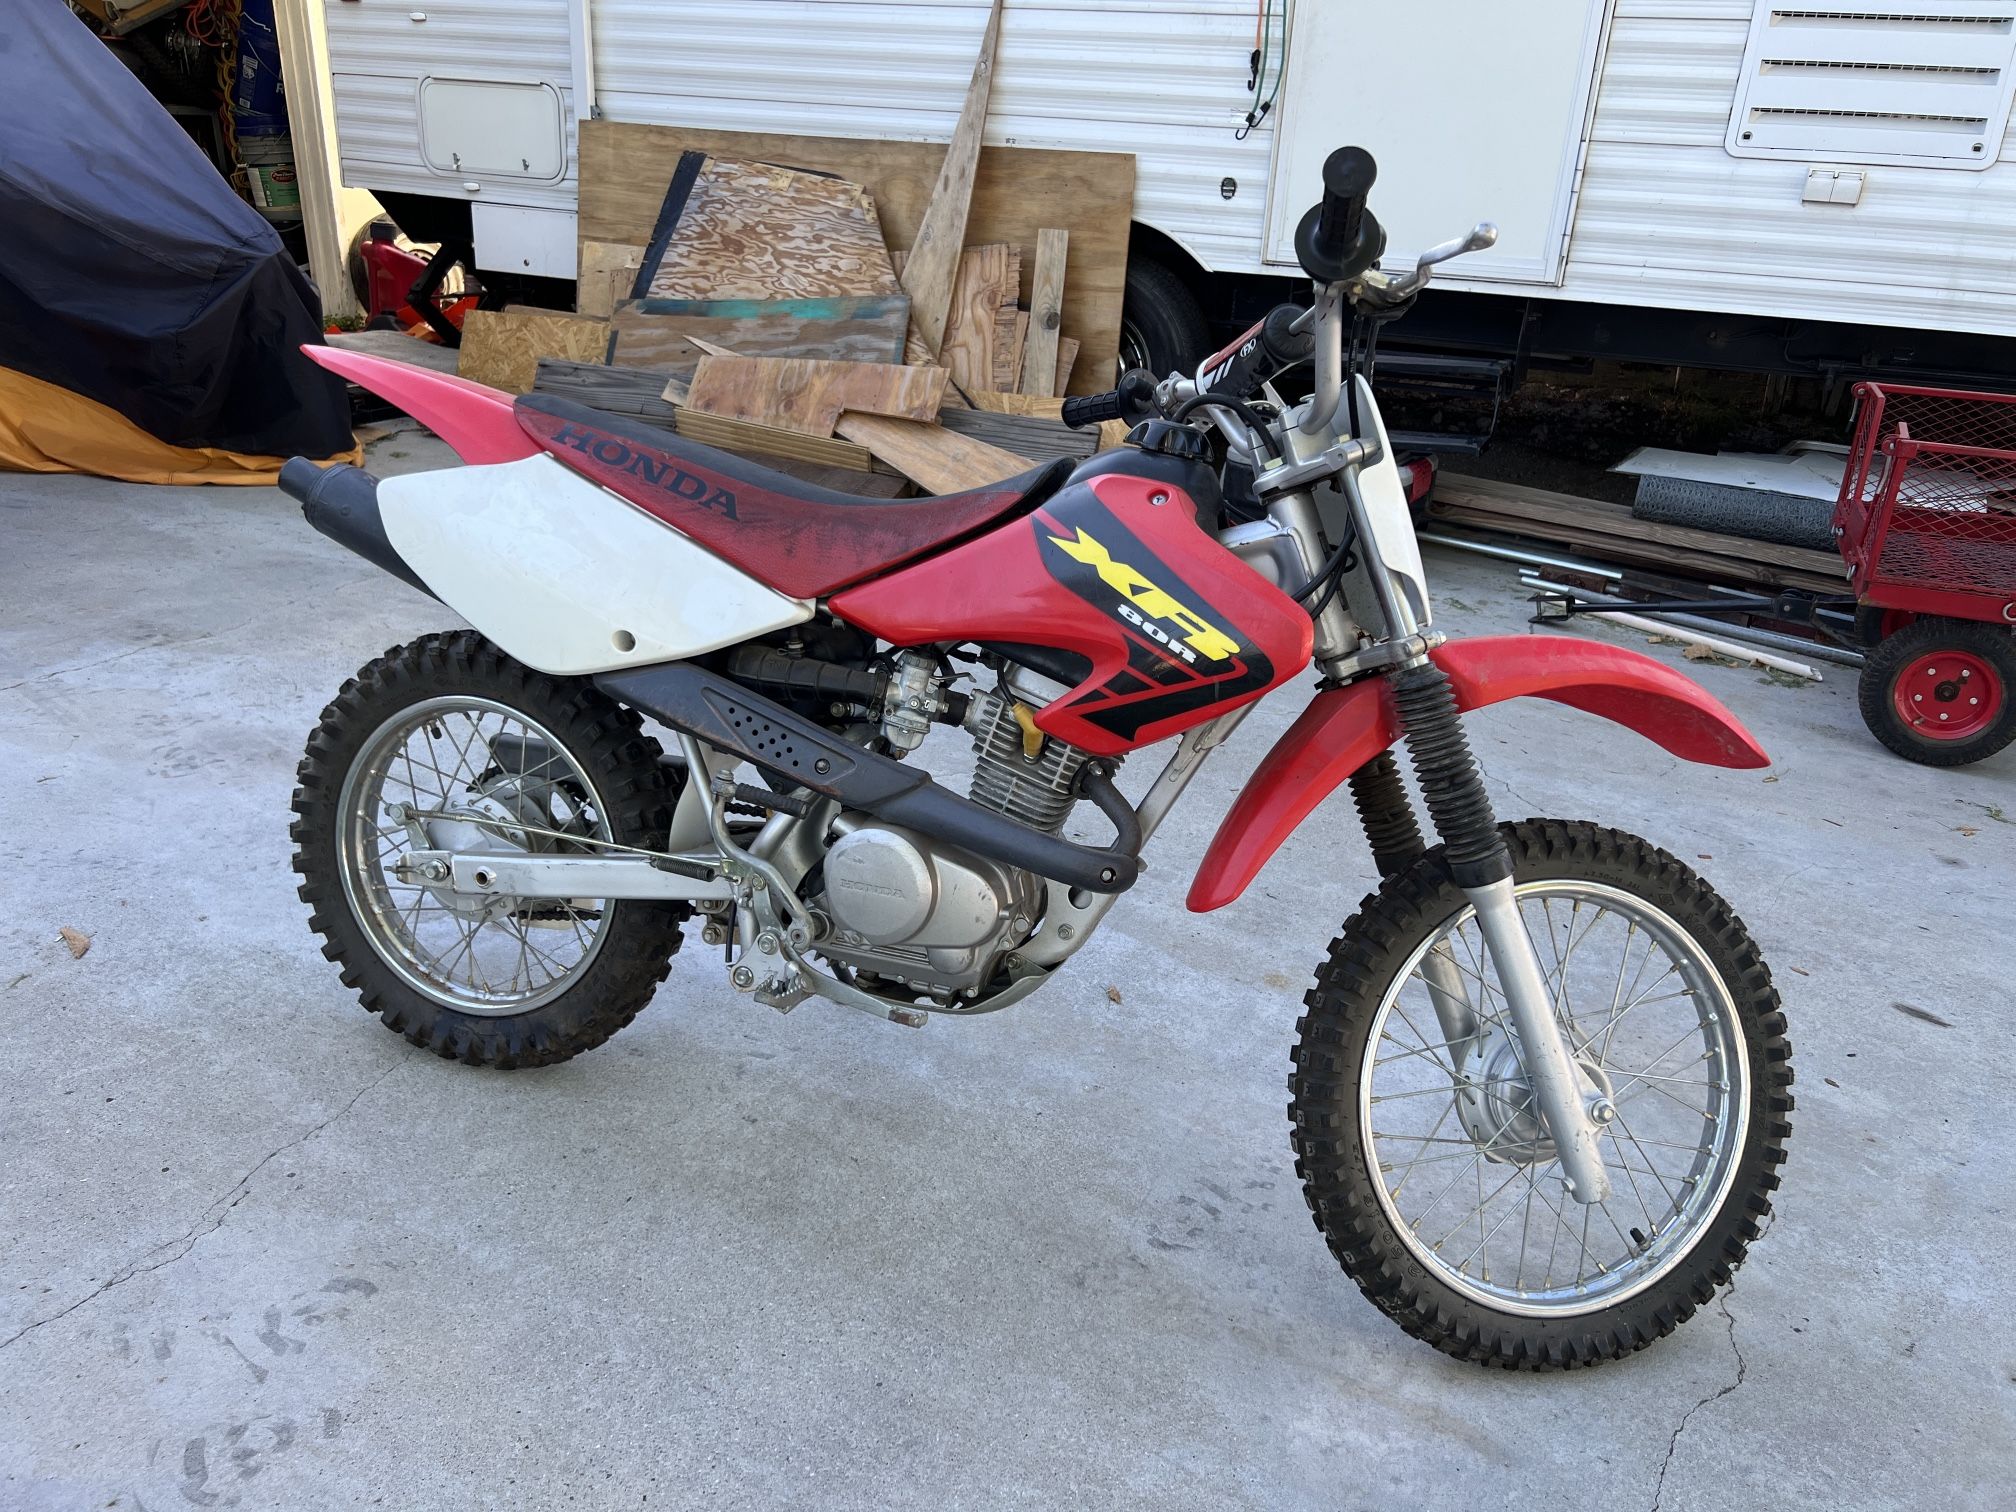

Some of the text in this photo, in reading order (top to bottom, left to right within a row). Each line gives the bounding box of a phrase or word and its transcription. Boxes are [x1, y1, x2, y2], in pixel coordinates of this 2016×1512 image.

[551, 423, 740, 521] HONDA
[1047, 526, 1240, 661] XR
[1117, 603, 1197, 664] 80R
[840, 878, 906, 899] HONDA
